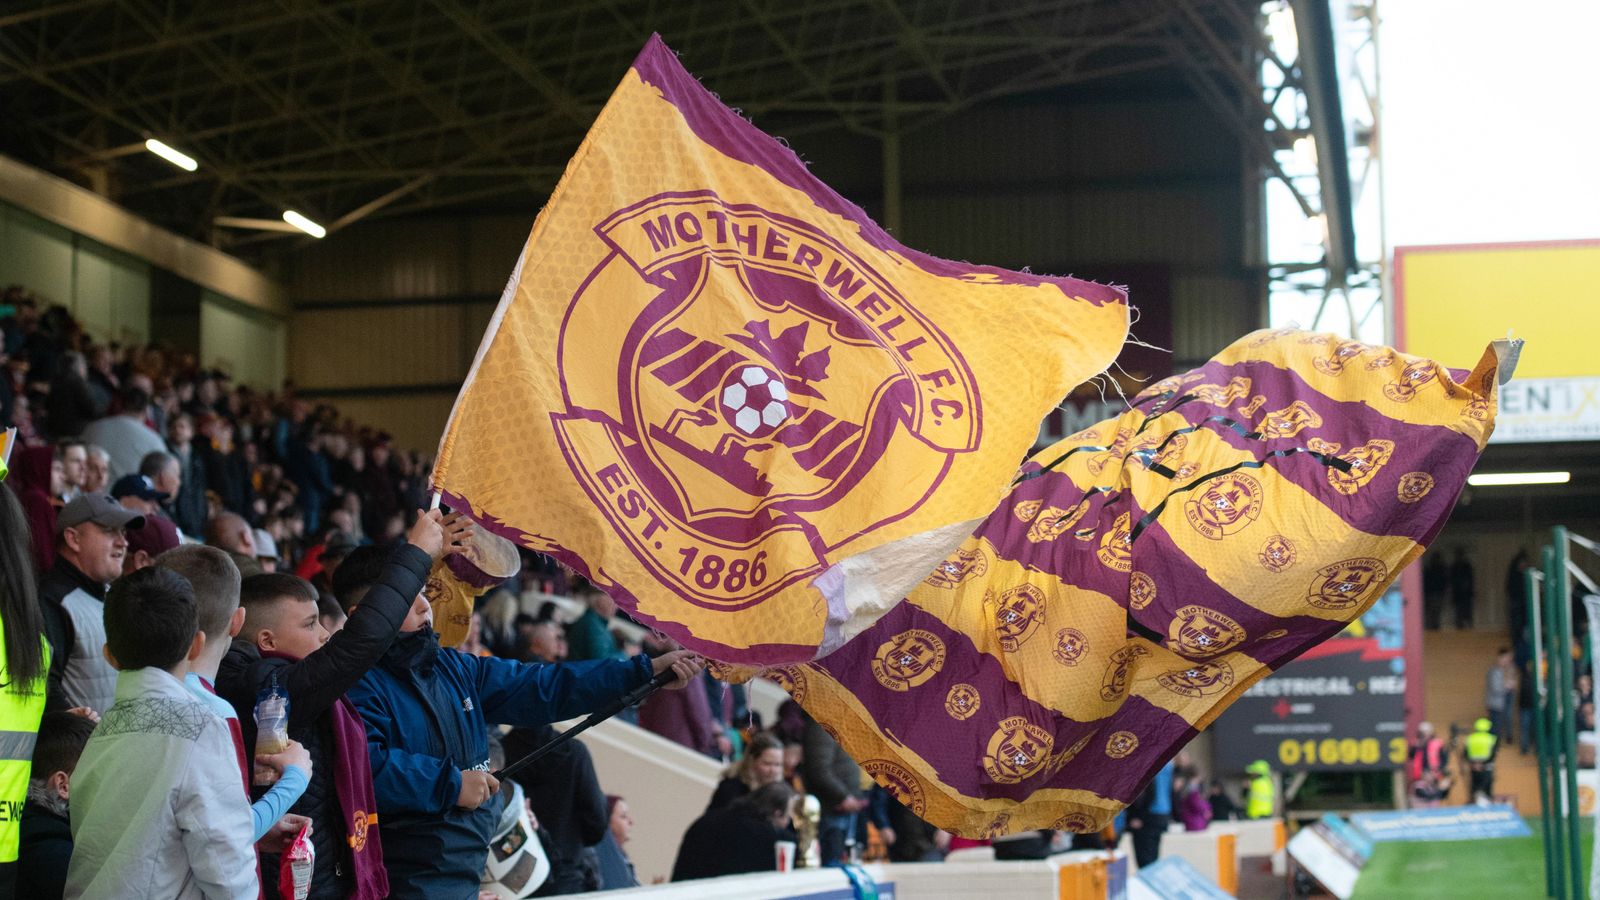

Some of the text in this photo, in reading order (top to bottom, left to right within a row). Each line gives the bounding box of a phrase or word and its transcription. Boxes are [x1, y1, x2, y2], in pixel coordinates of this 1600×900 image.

[641, 210, 964, 427] MOTHERWELL F.C.
[596, 462, 768, 593] EST. 1886
[1198, 522, 1215, 536] 1886
[1182, 607, 1241, 636] MOTHERWELL
[897, 630, 944, 653] MOTHERWELL
[883, 678, 900, 690] 1886
[1278, 737, 1380, 766] 01698
[864, 763, 920, 796] MOTHERWELL
